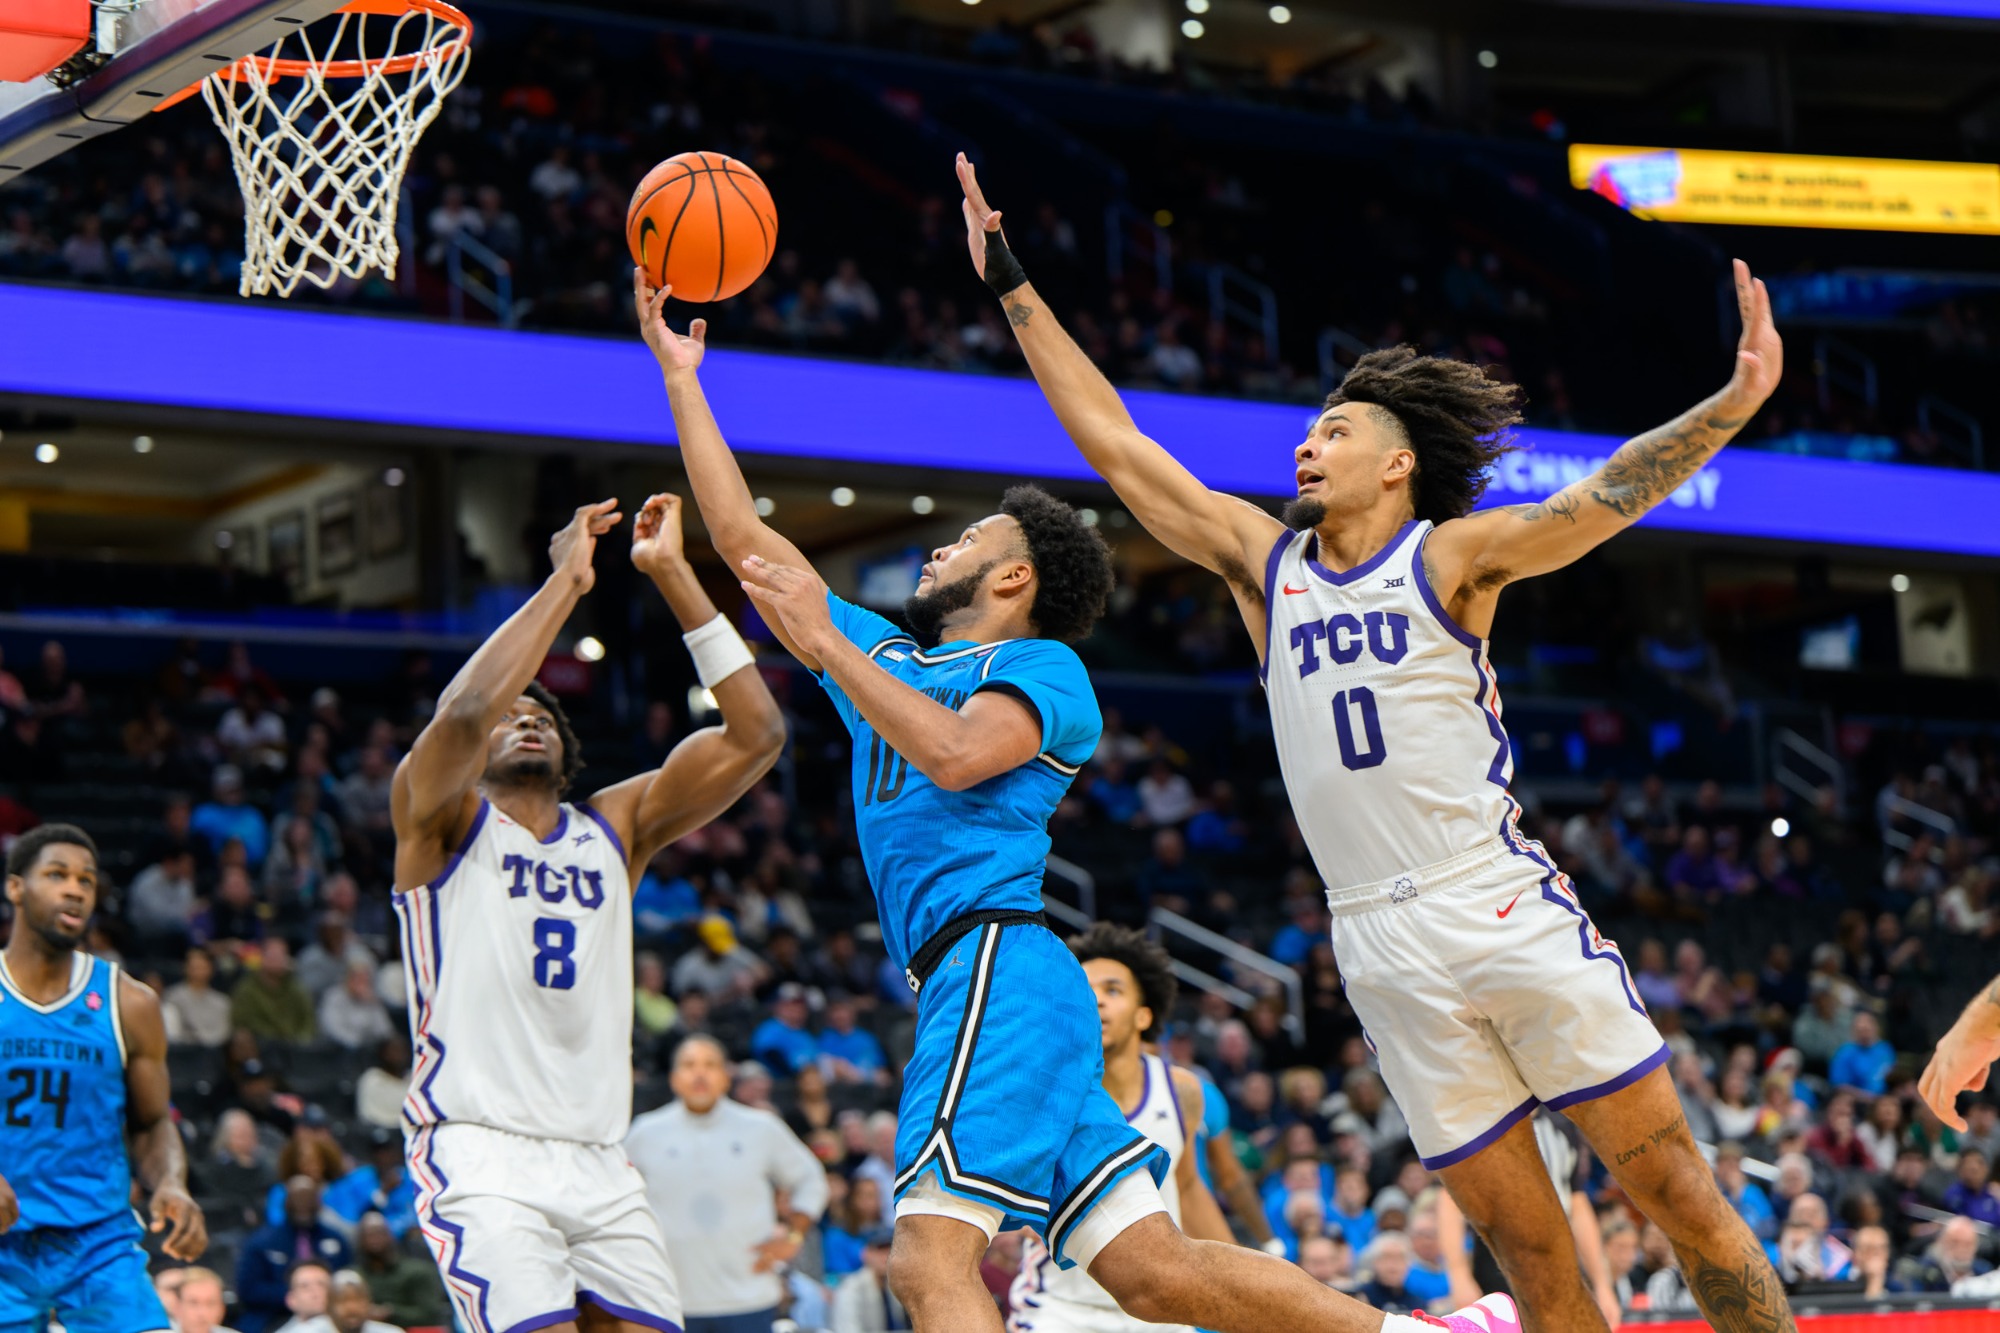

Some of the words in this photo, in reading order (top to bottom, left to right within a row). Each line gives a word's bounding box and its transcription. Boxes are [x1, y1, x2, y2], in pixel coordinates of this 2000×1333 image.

[1382, 575, 1406, 589] XII
[1290, 611, 1411, 680] TCU
[1331, 686, 1387, 771] 0
[864, 728, 908, 806] 10
[502, 854, 605, 911] TCU
[533, 917, 577, 990] 8
[1, 1037, 104, 1066] ORGETOWN
[6, 1068, 70, 1129] 24
[1615, 1143, 1646, 1166] Love
